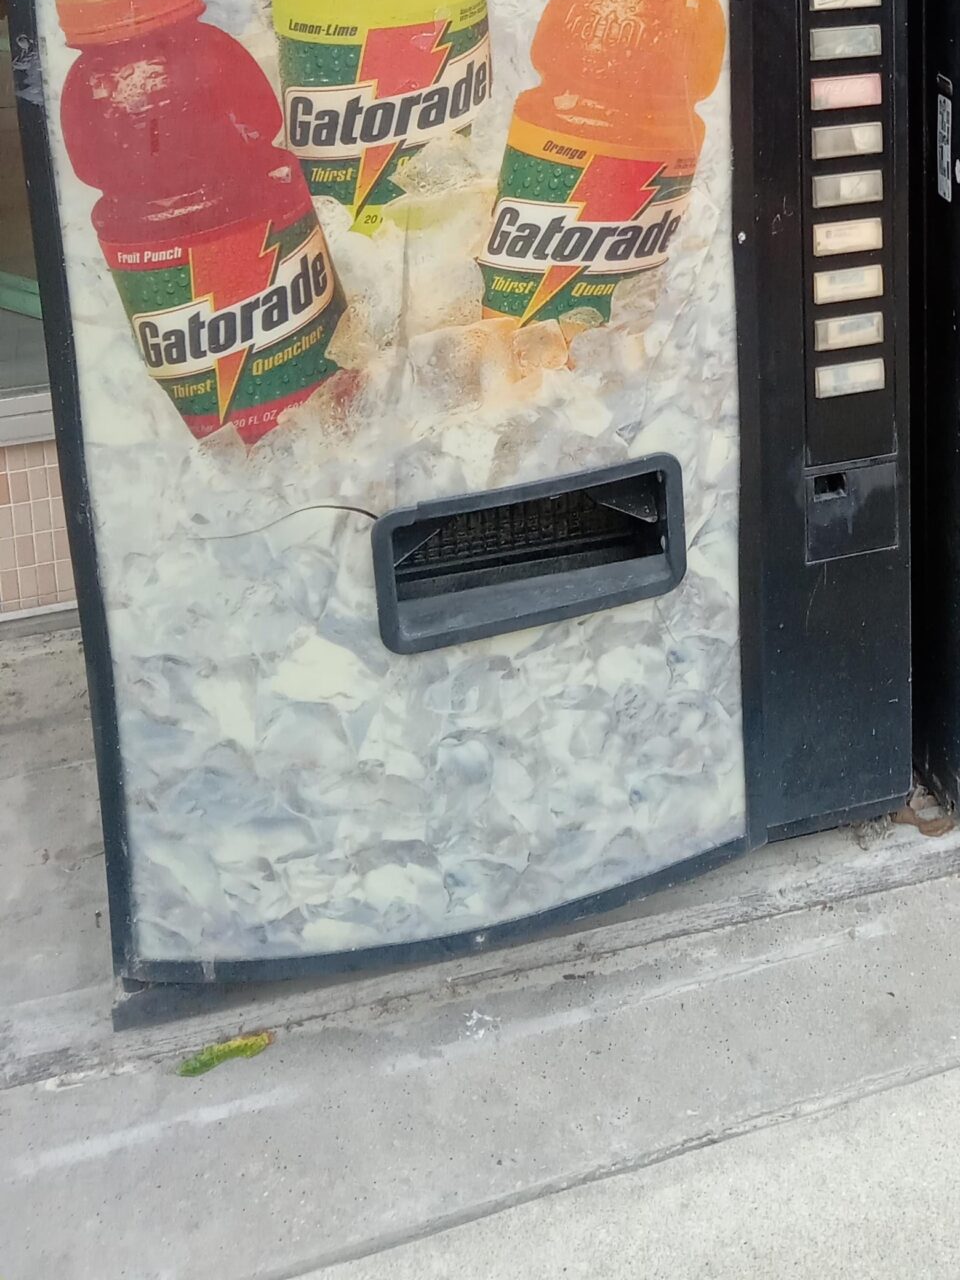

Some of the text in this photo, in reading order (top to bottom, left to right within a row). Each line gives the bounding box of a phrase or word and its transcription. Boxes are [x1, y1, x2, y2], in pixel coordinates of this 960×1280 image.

[289, 19, 358, 37] Lemon-Lime
[290, 60, 488, 148] Gatorade
[542, 140, 587, 160] Orange
[312, 167, 354, 182] Thirst
[363, 214, 378, 224] 20
[487, 206, 682, 263] Gatorade
[118, 246, 182, 263] Fruit Punch
[491, 276, 533, 293] Thirst
[138, 251, 329, 368] Gatorade
[173, 378, 213, 399] Thirst
[248, 416, 259, 426] FL
[263, 410, 278, 422] OZ
